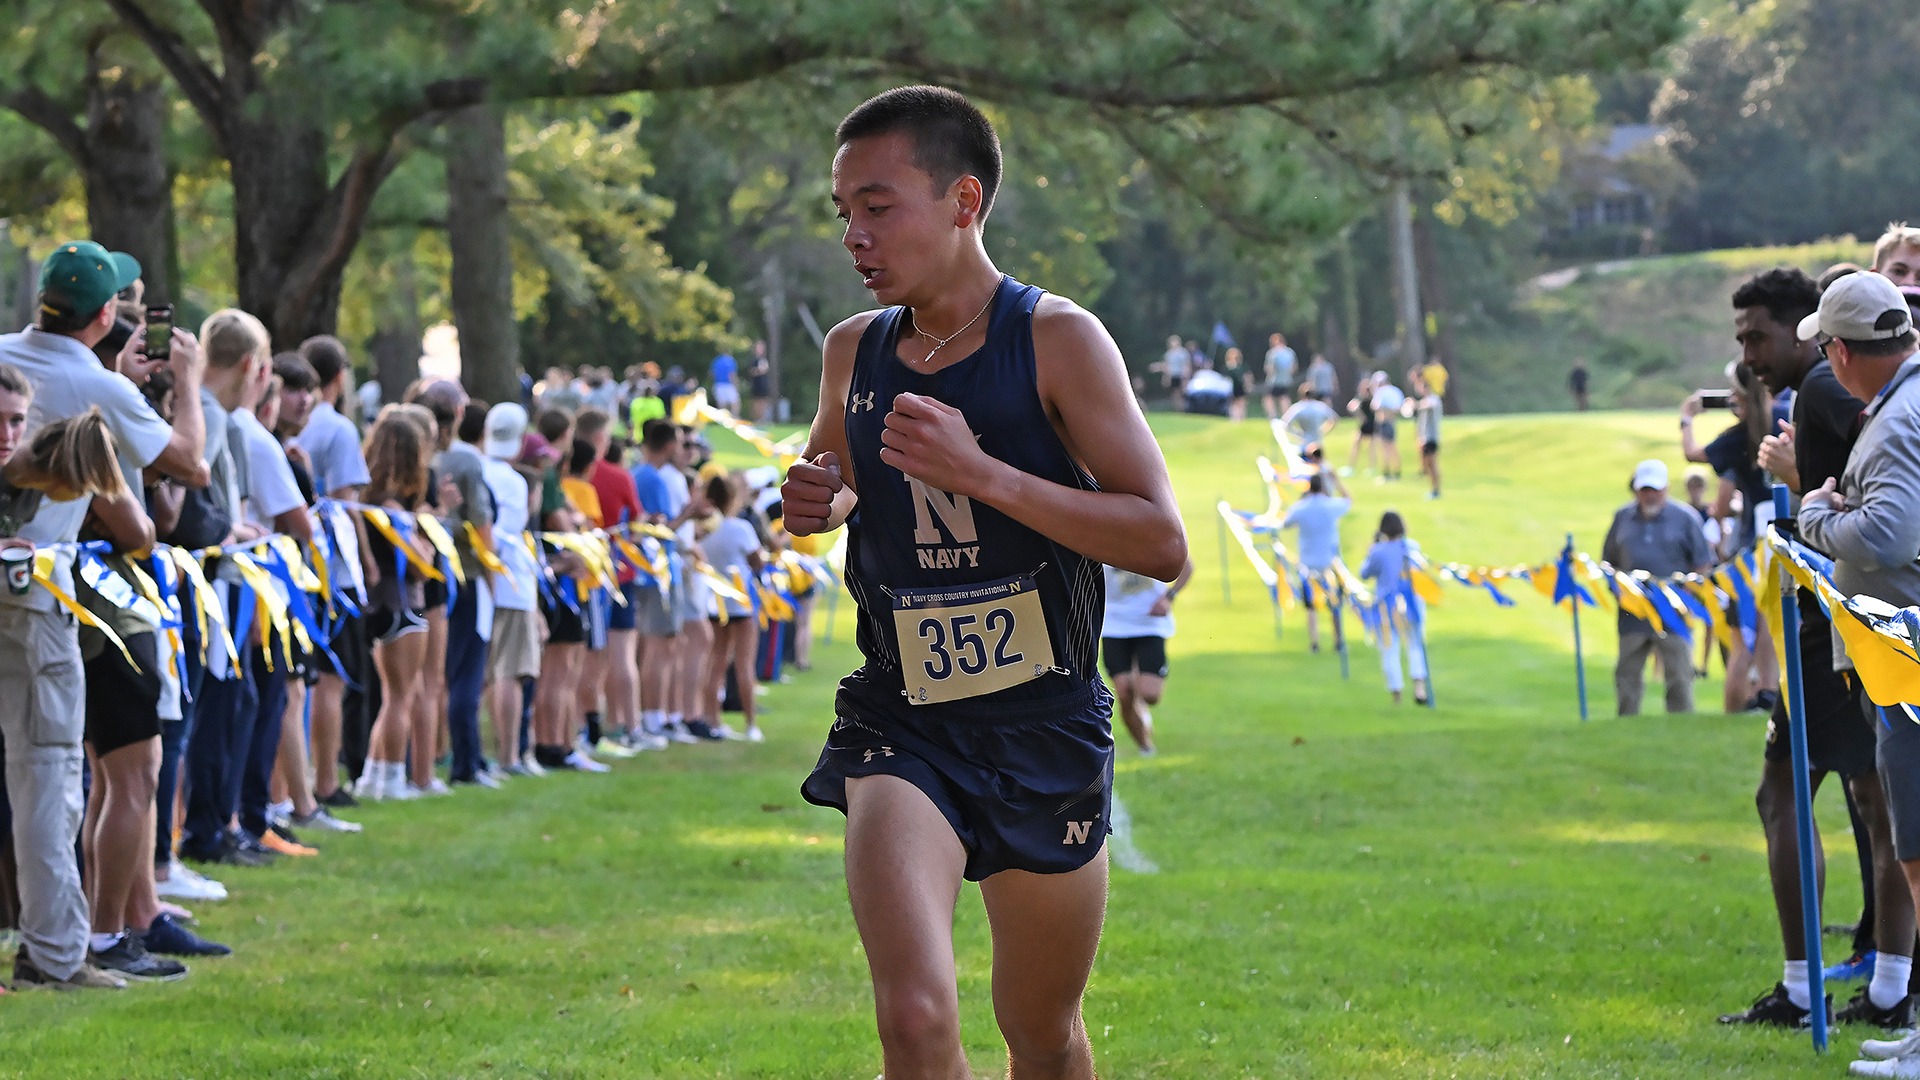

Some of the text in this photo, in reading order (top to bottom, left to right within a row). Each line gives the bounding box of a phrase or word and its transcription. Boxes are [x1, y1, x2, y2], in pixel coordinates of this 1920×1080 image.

[904, 472, 979, 544] N
[916, 546, 980, 569] NAVY
[901, 581, 1021, 607] N NAVY CROSS COUNTRY INVITATIONAL N
[918, 607, 1024, 681] 352
[1063, 821, 1092, 844] N
